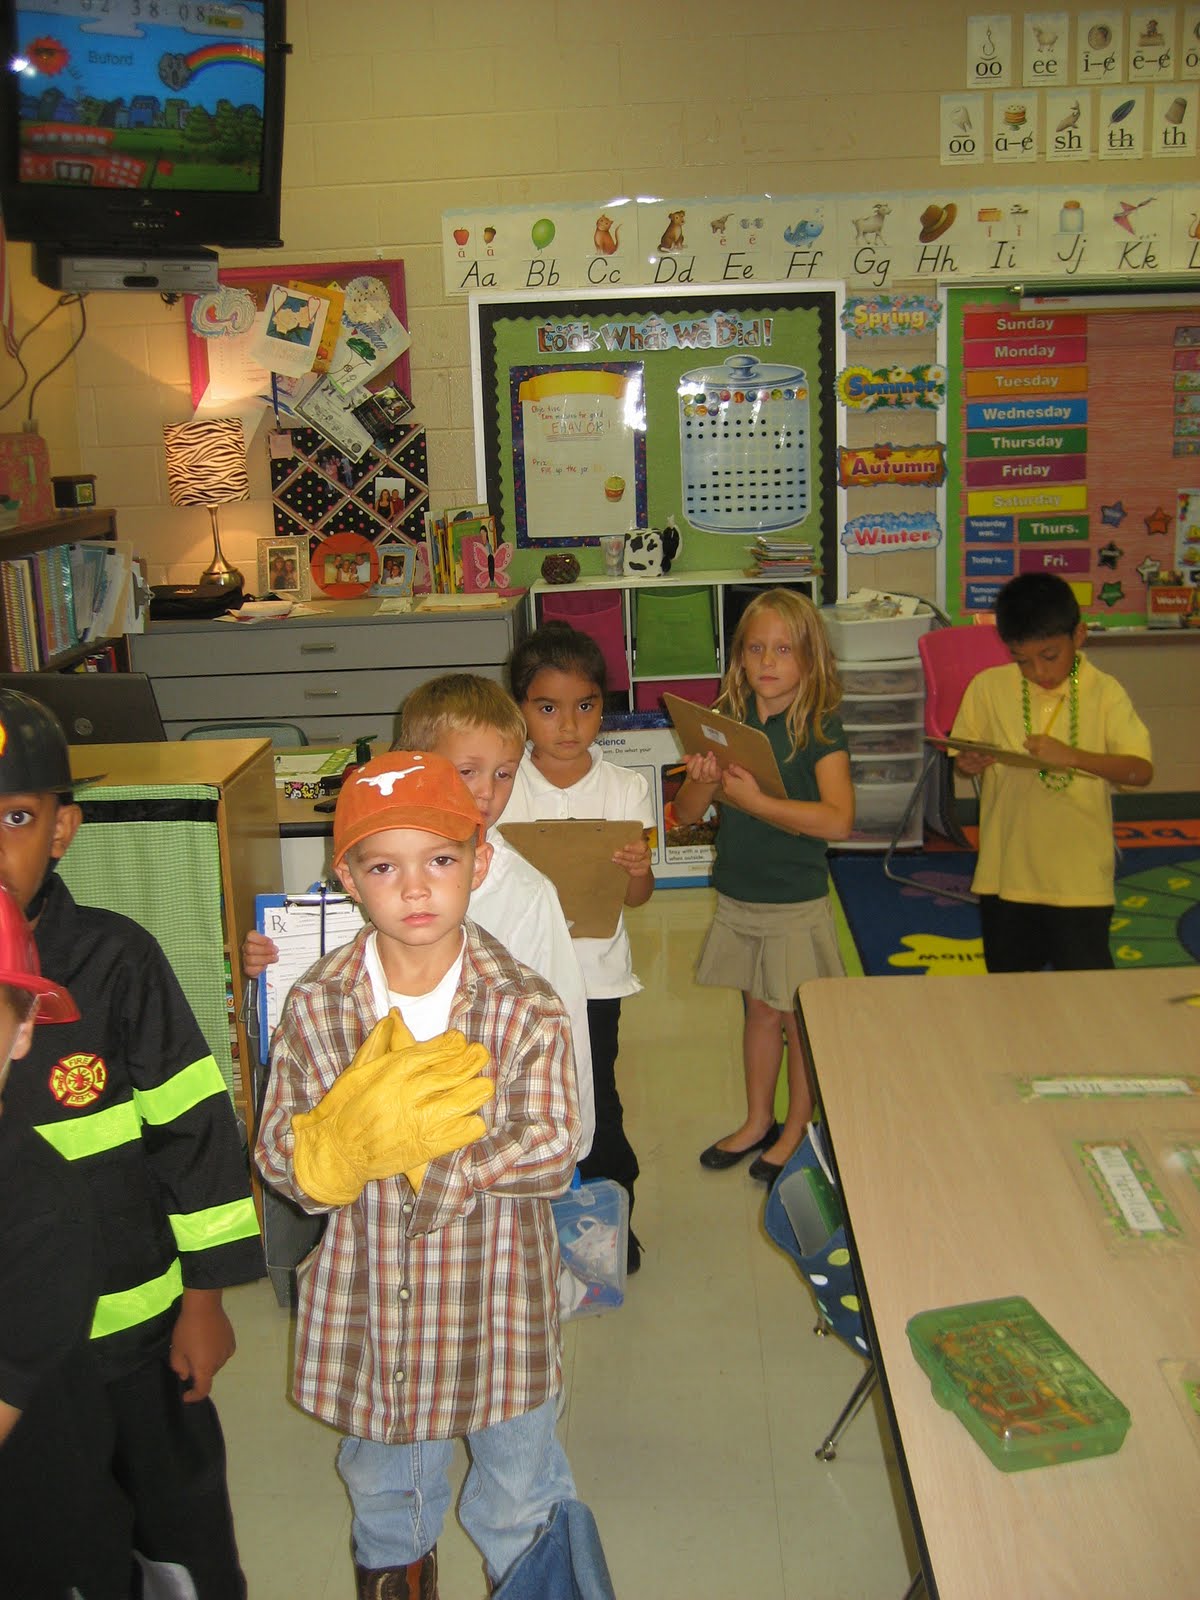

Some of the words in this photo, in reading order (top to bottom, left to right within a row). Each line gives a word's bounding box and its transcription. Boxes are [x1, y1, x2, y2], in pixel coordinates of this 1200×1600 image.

[1032, 59, 1058, 74] ee
[1054, 130, 1082, 150] sh
[1108, 128, 1134, 148] th
[1162, 127, 1186, 146] th
[461, 260, 498, 288] Aa
[525, 259, 560, 287] Bb
[587, 256, 621, 284] Cc
[654, 255, 696, 284] Dd
[722, 252, 754, 280] Ee
[786, 251, 823, 279] Ff
[853, 247, 891, 287] Gg
[917, 244, 958, 273] Hh
[990, 240, 1016, 269] Ii
[1057, 233, 1087, 275] Jj
[1118, 241, 1159, 270] Kk
[854, 304, 926, 329] Spring
[996, 317, 1055, 332] Sunday
[537, 324, 600, 352] Look
[601, 324, 669, 350] What
[673, 322, 712, 347] We
[994, 344, 1056, 359] Monday
[849, 376, 937, 397] Summer
[994, 374, 1060, 389] Tuesday
[982, 406, 1072, 422] Wednesday
[991, 435, 1064, 451] Thursday
[851, 459, 936, 476] Autumn
[1002, 463, 1051, 479] Friday
[993, 493, 1063, 510] Saturday
[970, 520, 1008, 529] Yesterday
[1030, 522, 1080, 536] Thurs.
[854, 527, 932, 546] Winter
[971, 555, 994, 565] Today
[1043, 554, 1069, 568] Fri.
[68, 1057, 90, 1067] FIRE
